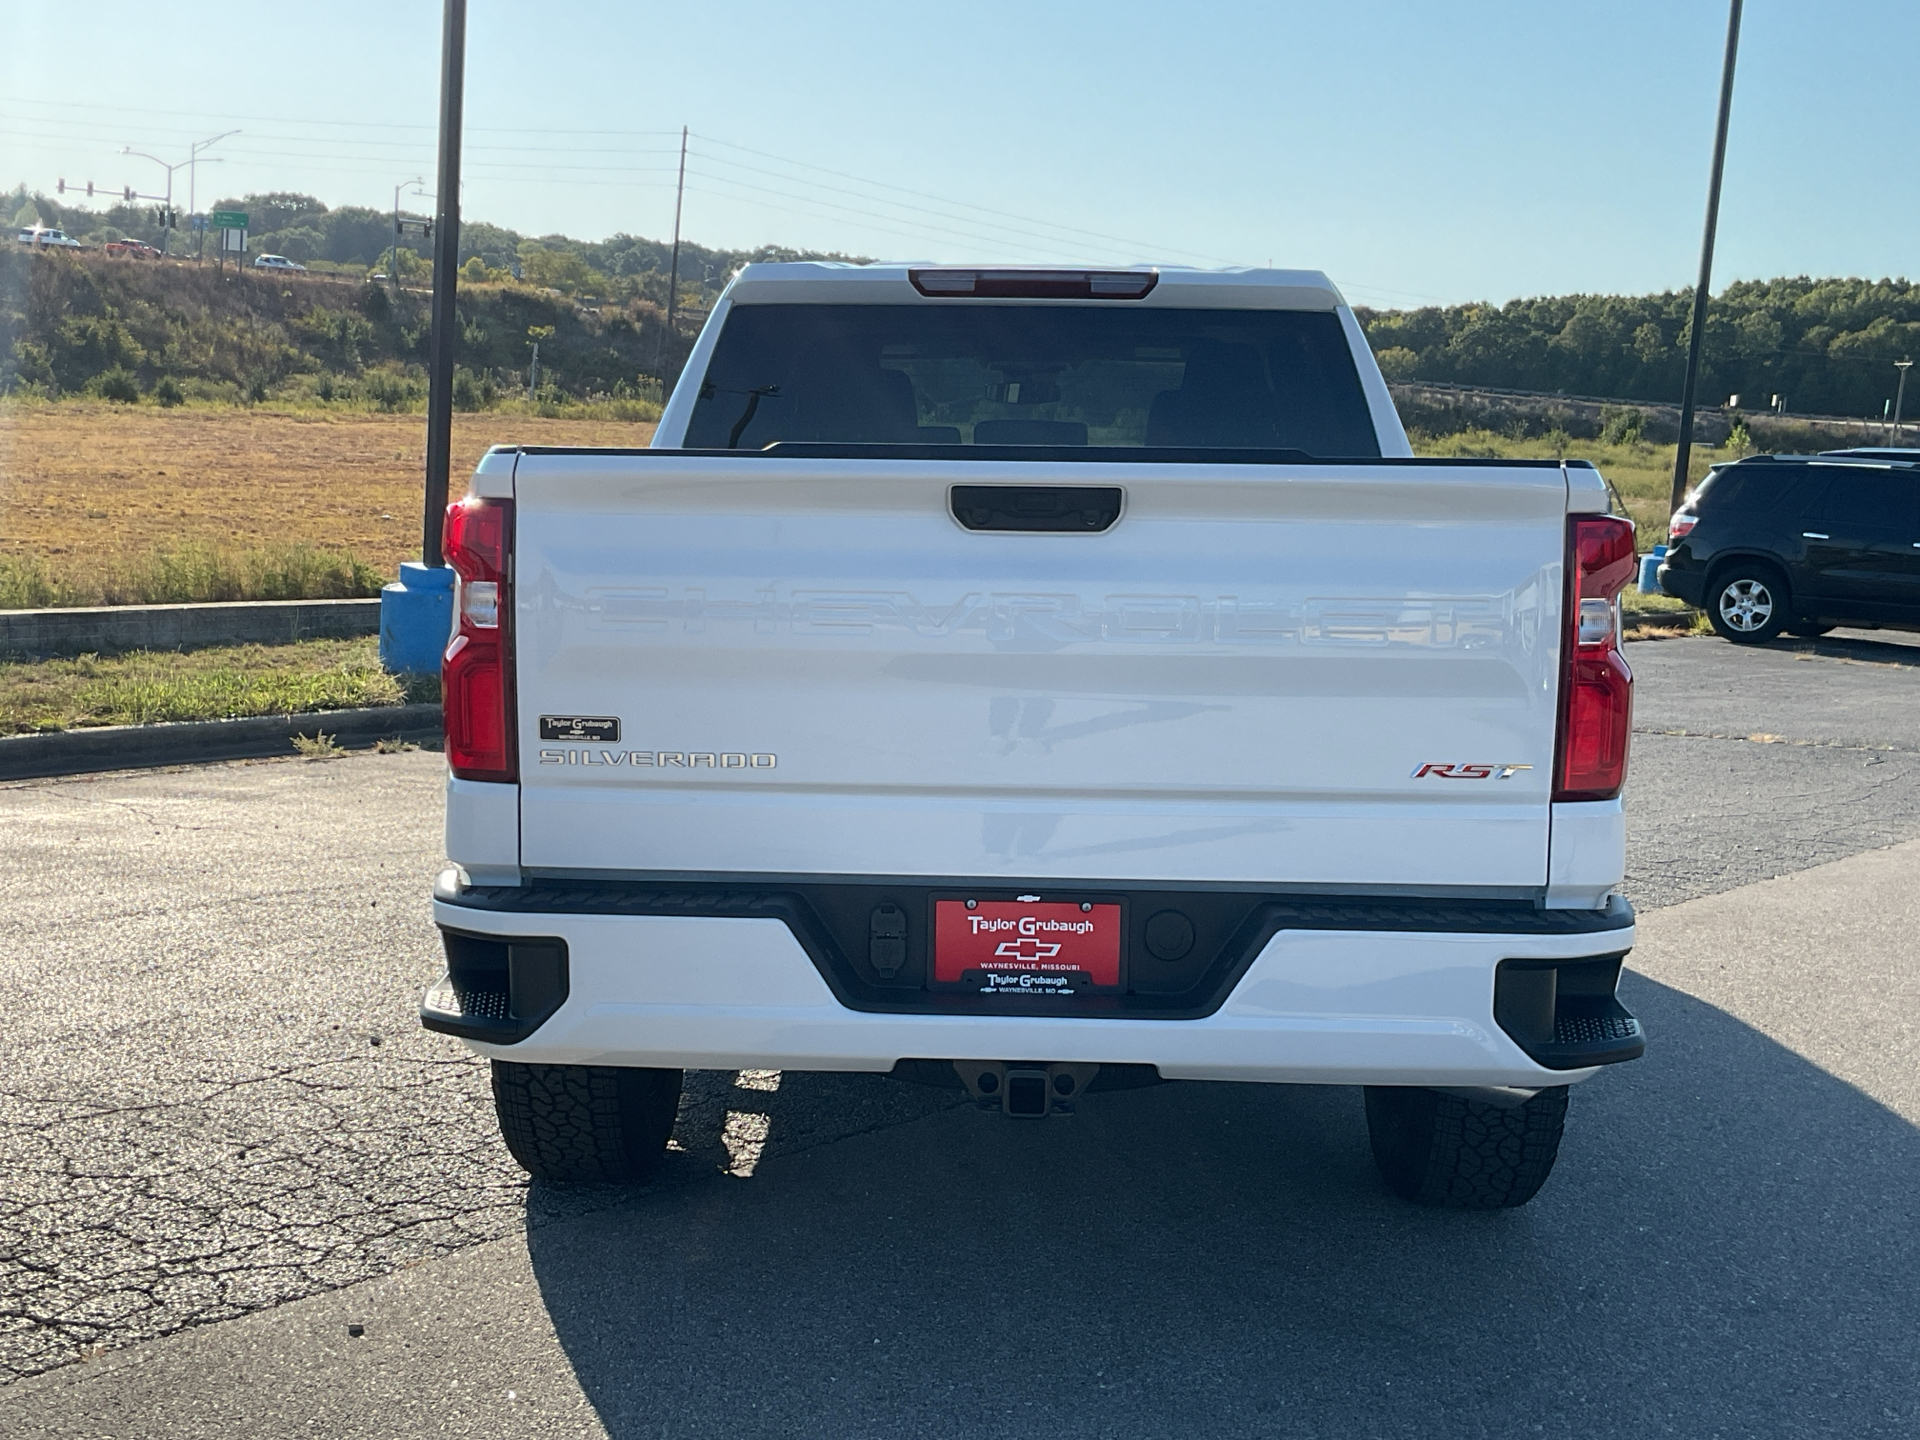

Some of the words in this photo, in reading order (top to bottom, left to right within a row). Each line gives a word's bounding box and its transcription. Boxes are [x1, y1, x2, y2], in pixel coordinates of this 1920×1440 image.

[584, 586, 1492, 646] CHEVROLET
[546, 718, 571, 728] Taylor
[572, 719, 612, 729] Grubaugh
[539, 749, 777, 769] SILVERADO
[1410, 762, 1534, 779] RST
[967, 916, 1016, 934] Taylor
[1018, 917, 1093, 935] Grubaugh
[980, 962, 1039, 970] WAYNESVILLE,
[1041, 963, 1080, 971] MISSOURI
[987, 973, 1018, 986] Taylor
[1019, 974, 1067, 987] Grubaugh
